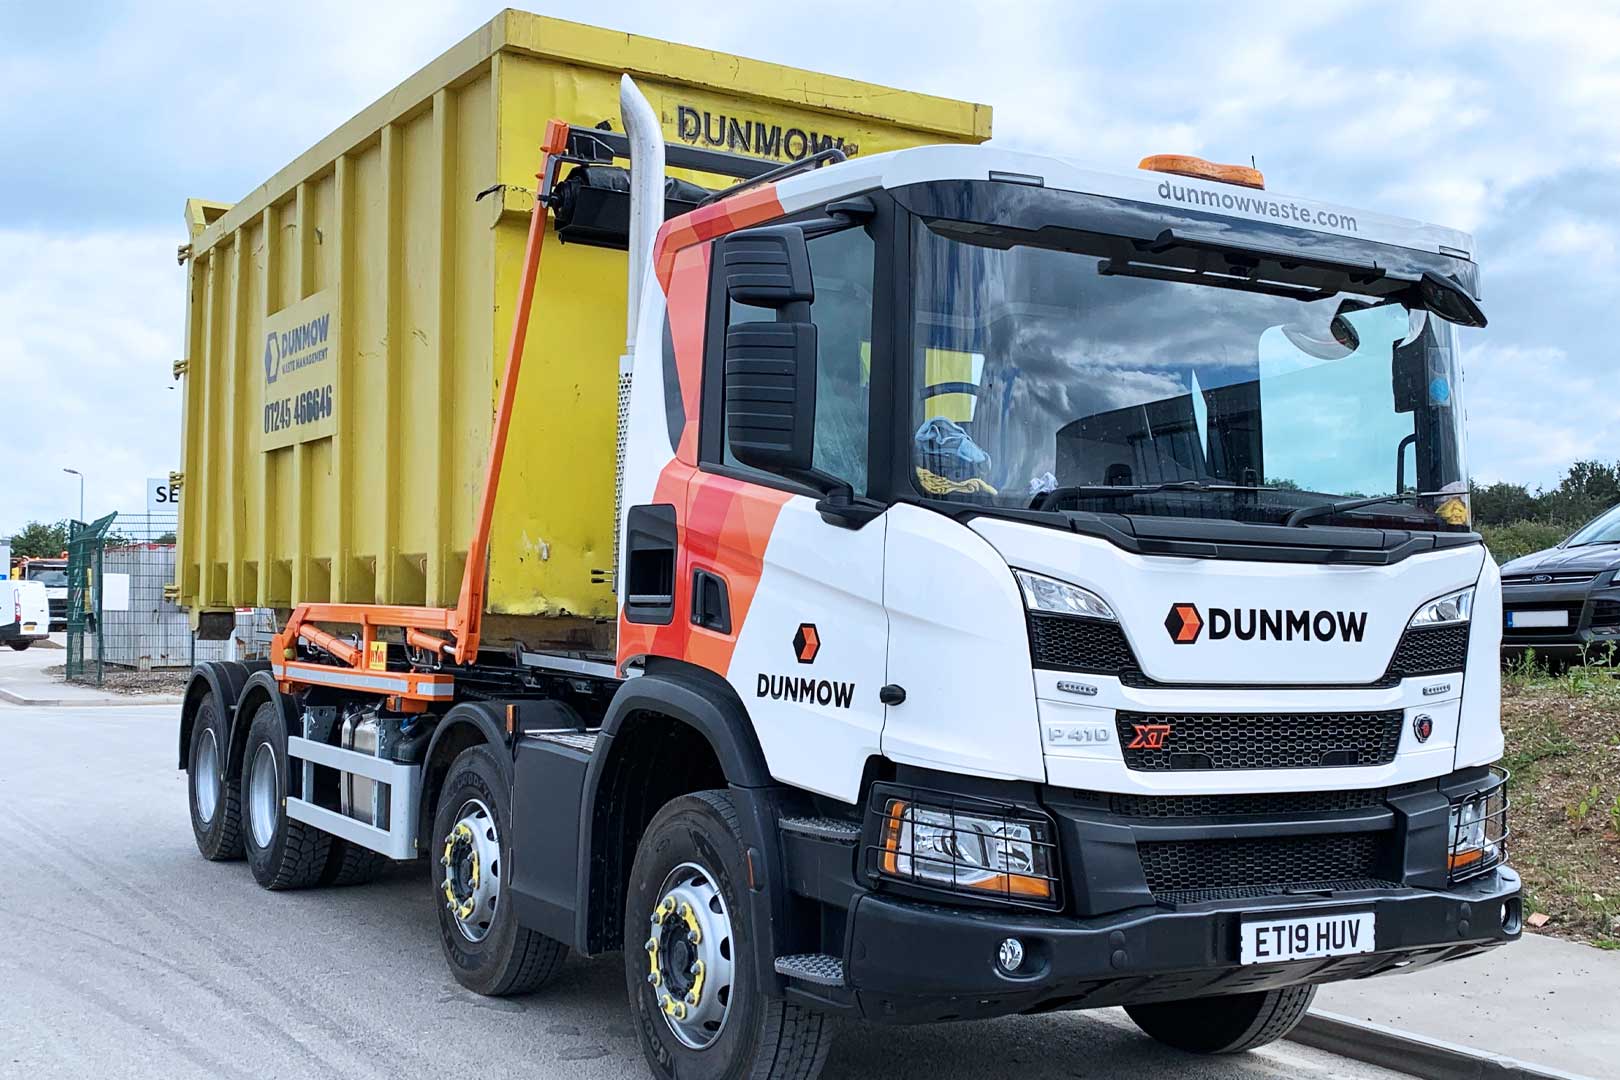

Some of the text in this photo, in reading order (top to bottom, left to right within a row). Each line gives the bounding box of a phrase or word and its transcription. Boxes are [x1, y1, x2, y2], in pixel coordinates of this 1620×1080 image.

[677, 105, 845, 163] DUNMOW
[1157, 180, 1358, 232] dunmowwaste.com
[281, 313, 330, 358] DUNMOW
[1208, 607, 1368, 642] DUNMOW
[756, 672, 856, 709] DUNMOW
[1048, 728, 1110, 742] P 410
[1128, 724, 1170, 749] XT
[1255, 918, 1361, 957] ET19 HUV
